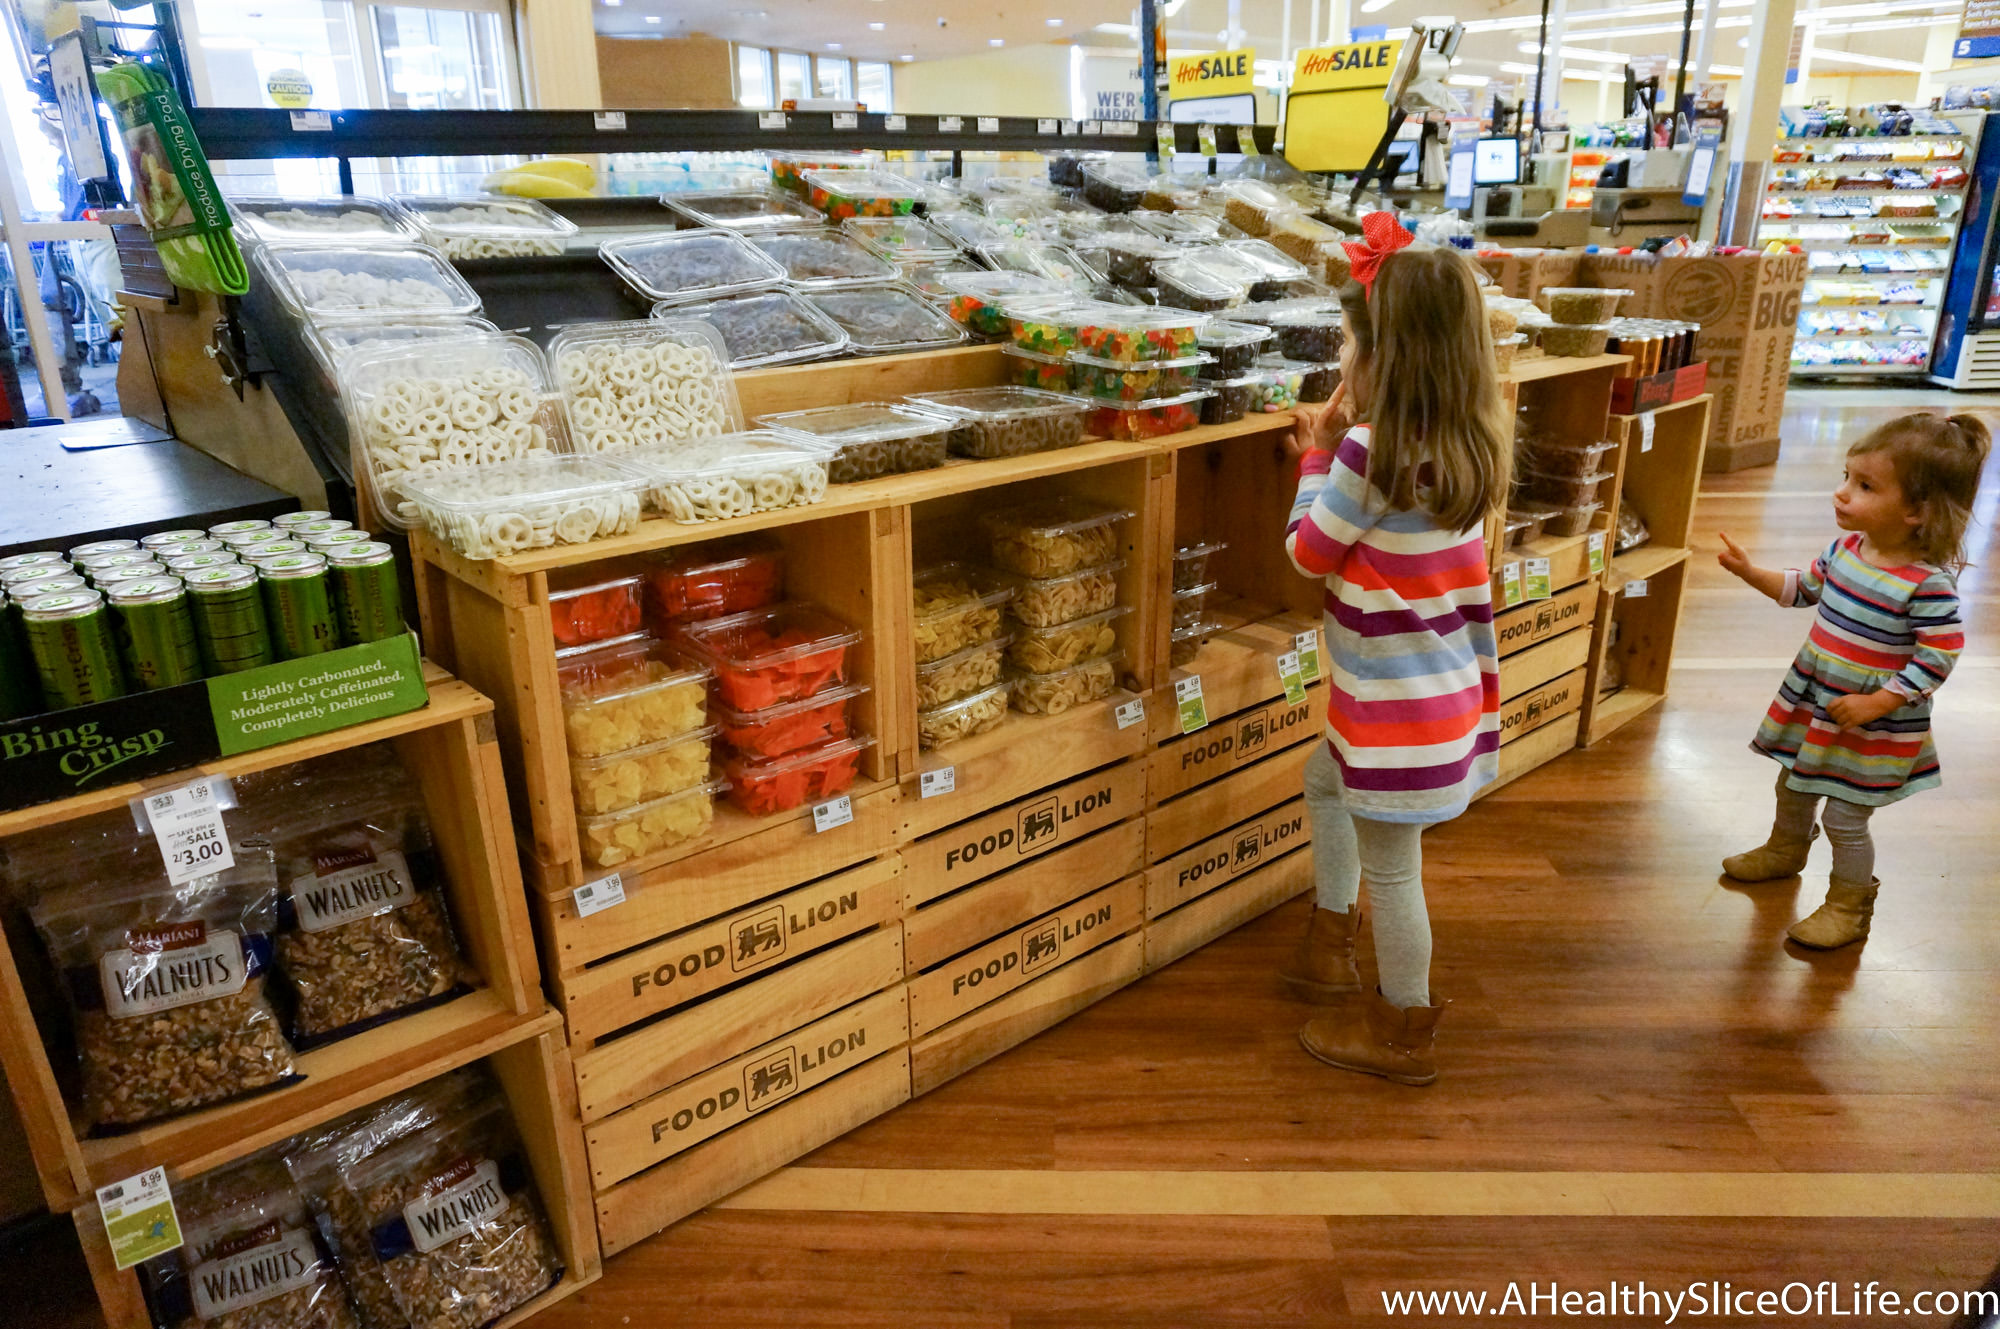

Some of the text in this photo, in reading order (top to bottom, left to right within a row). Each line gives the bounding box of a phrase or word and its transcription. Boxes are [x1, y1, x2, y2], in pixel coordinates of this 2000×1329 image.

[1176, 60, 1202, 83] Hot
[1200, 54, 1247, 79] SALE
[1303, 44, 1391, 75] Hot SALE
[1957, 40, 1971, 56] 5
[155, 95, 221, 227] Produce Drying Pad
[1762, 255, 1806, 287] SAVE
[1755, 290, 1799, 331] BIG
[1500, 602, 1580, 643] FOOD LION
[231, 670, 405, 721] Moderately Caffeinated.
[242, 659, 387, 702] Lightly Carbonated.
[1543, 688, 1569, 710] LION
[241, 689, 395, 734] Completely Delicious
[0, 721, 103, 760] Bing
[59, 728, 165, 776] Crisp
[1182, 704, 1310, 771] FOOD LION
[188, 785, 209, 800] 1.99
[187, 828, 217, 845] SALE
[946, 787, 1112, 872] FOOD LION
[1178, 816, 1302, 888] FOOD LION
[304, 869, 403, 919] WALNUTS
[632, 891, 858, 997] FOOD LION
[953, 904, 1111, 996] FOOD LION
[114, 954, 232, 1003] WALNUTS
[651, 1027, 866, 1144] FOOD LION
[141, 1171, 162, 1188] 8.99
[417, 1178, 500, 1239] WALNUTS
[202, 1247, 305, 1304] WALNUTS
